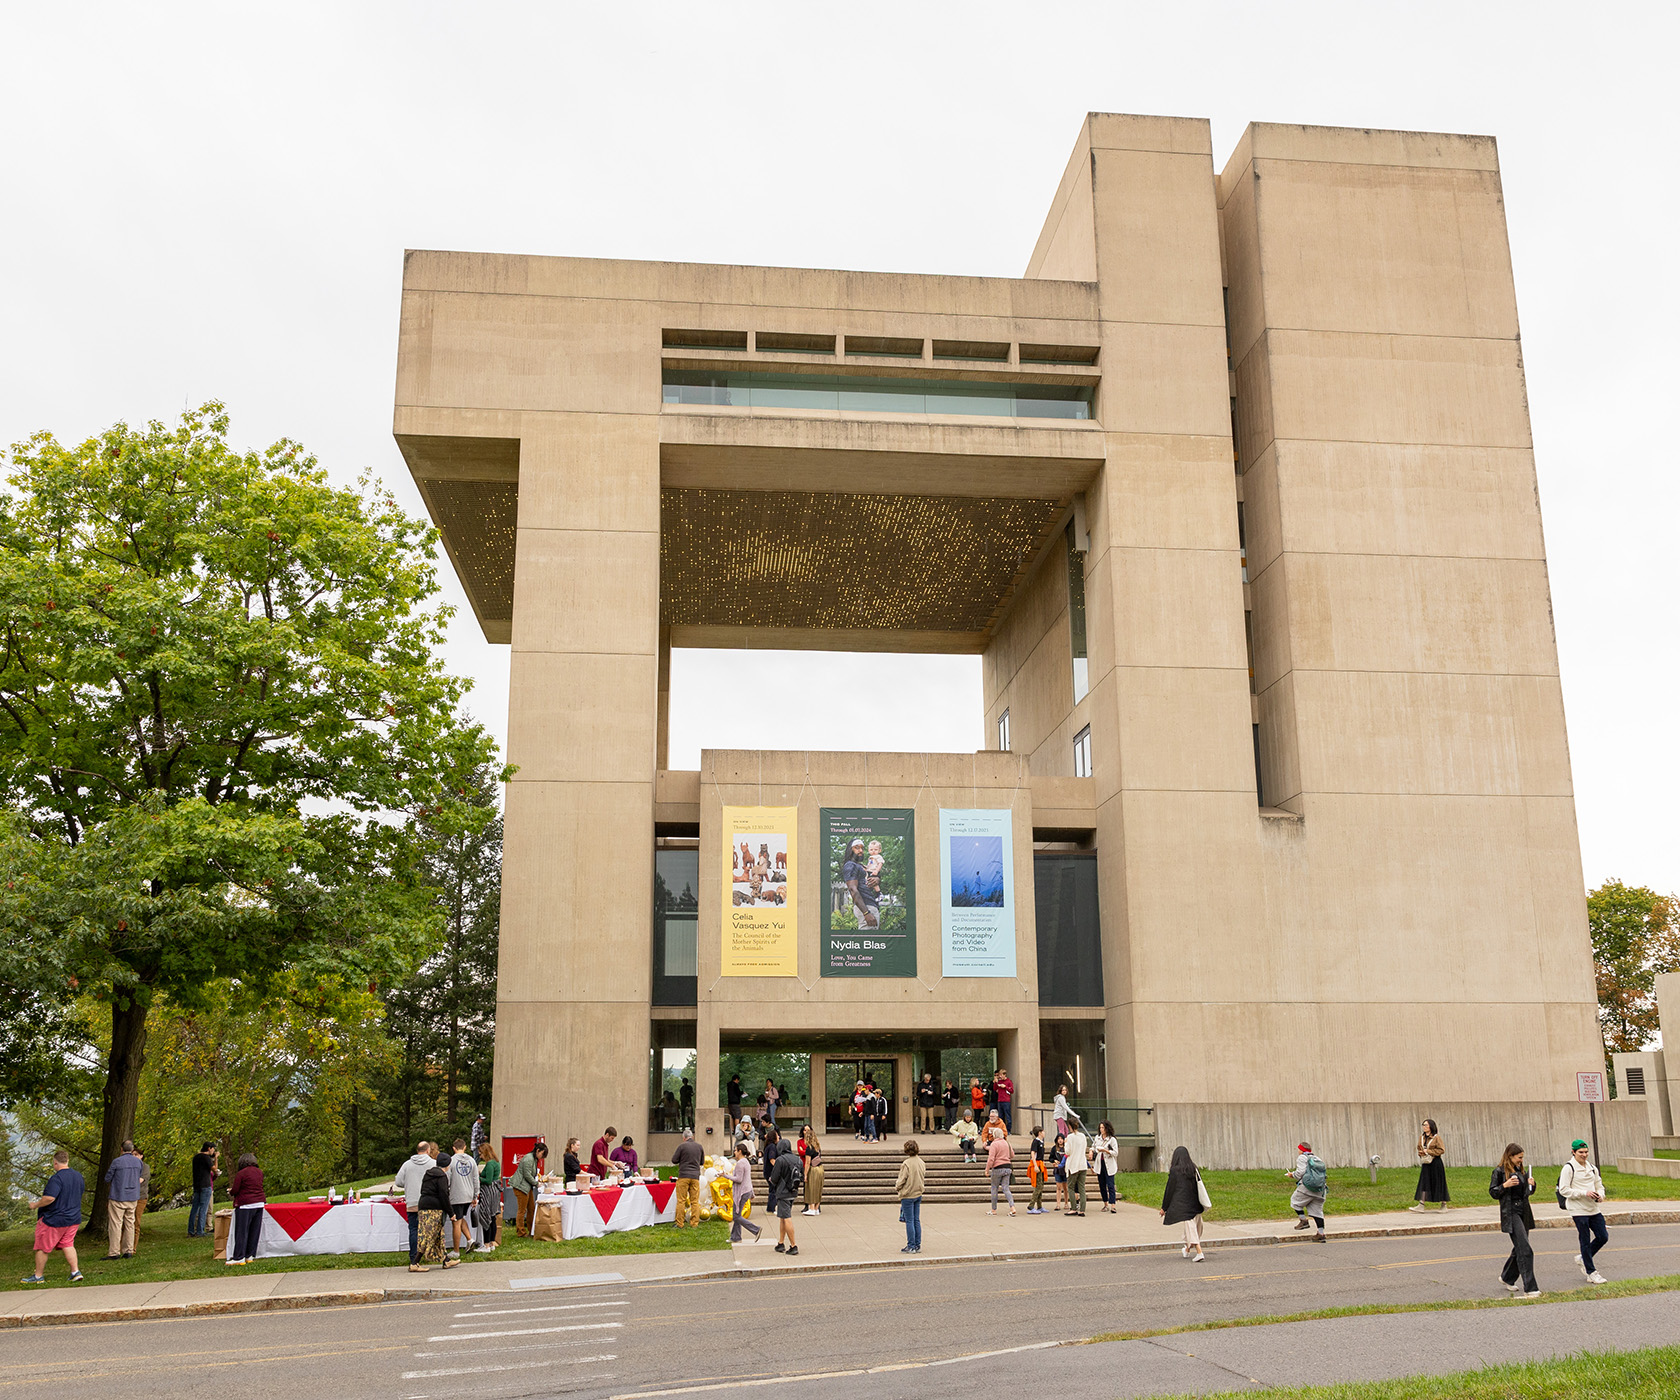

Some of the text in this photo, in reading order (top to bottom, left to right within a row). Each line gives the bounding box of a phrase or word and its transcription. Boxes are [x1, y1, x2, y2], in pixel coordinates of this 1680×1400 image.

[732, 922, 769, 930] Vasquez
[831, 941, 886, 951] Nydia Blas
